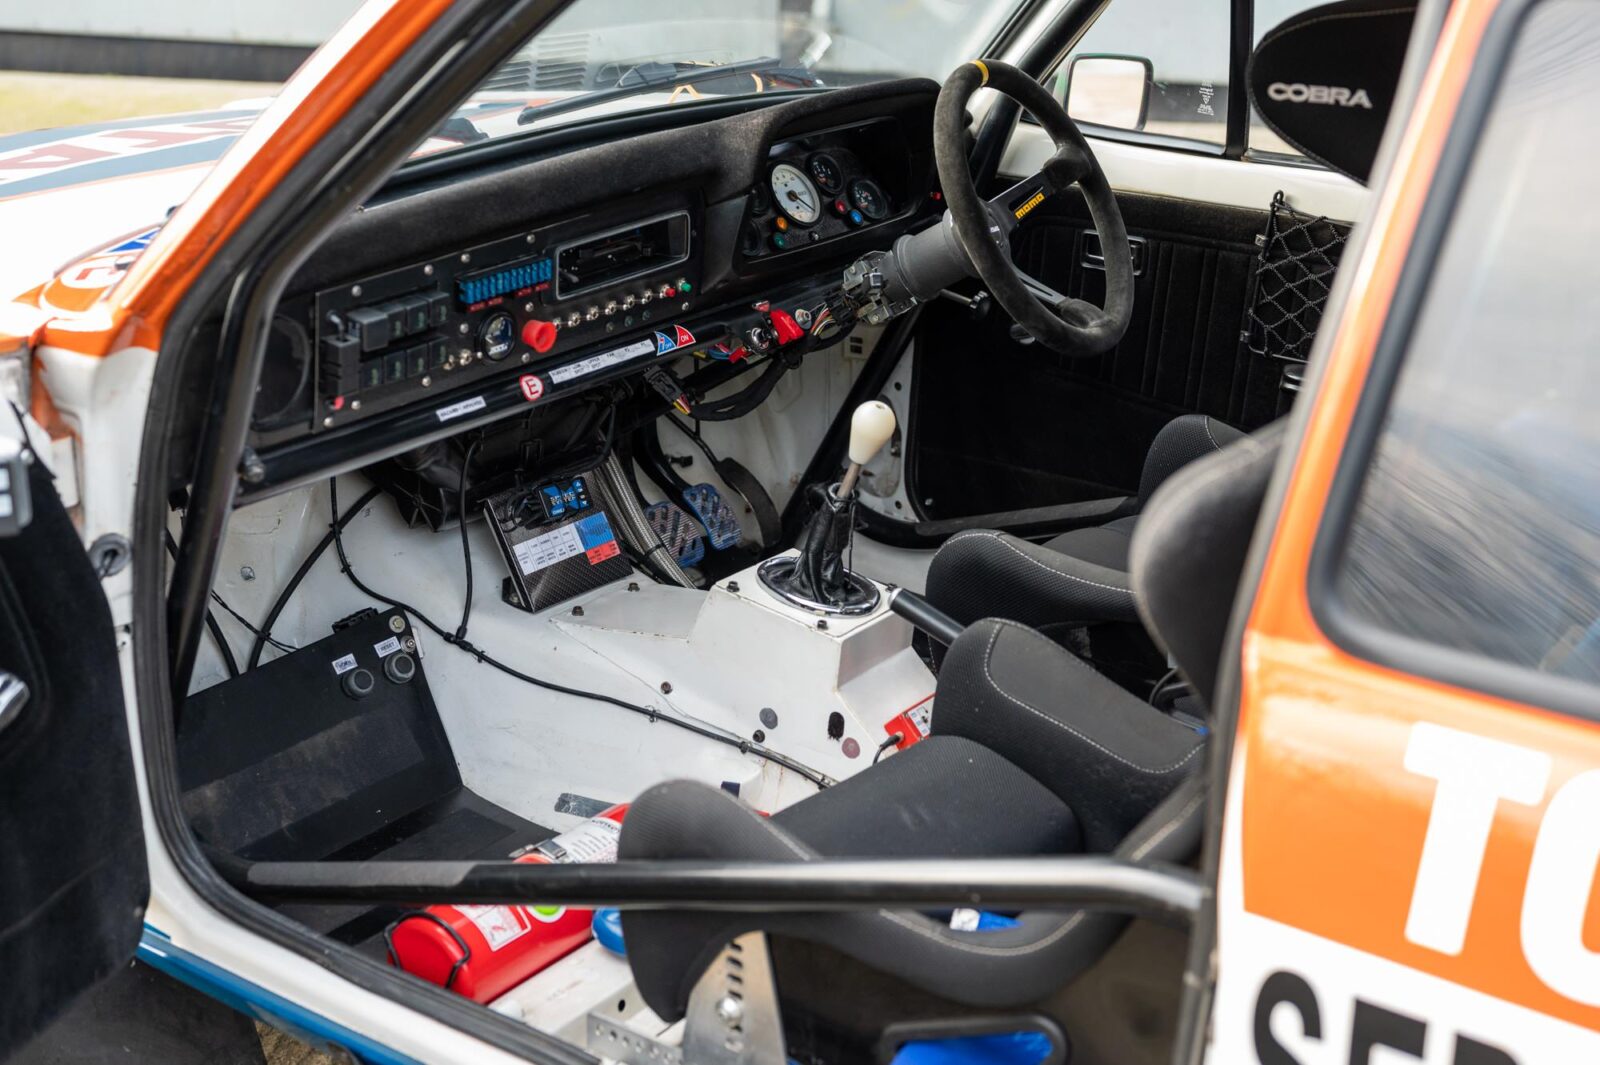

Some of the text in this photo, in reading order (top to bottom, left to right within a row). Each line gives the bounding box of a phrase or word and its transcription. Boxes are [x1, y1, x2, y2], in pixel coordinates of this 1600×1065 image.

[1267, 82, 1372, 109] COBRA
[680, 333, 689, 342] ON
[525, 379, 539, 396] E
